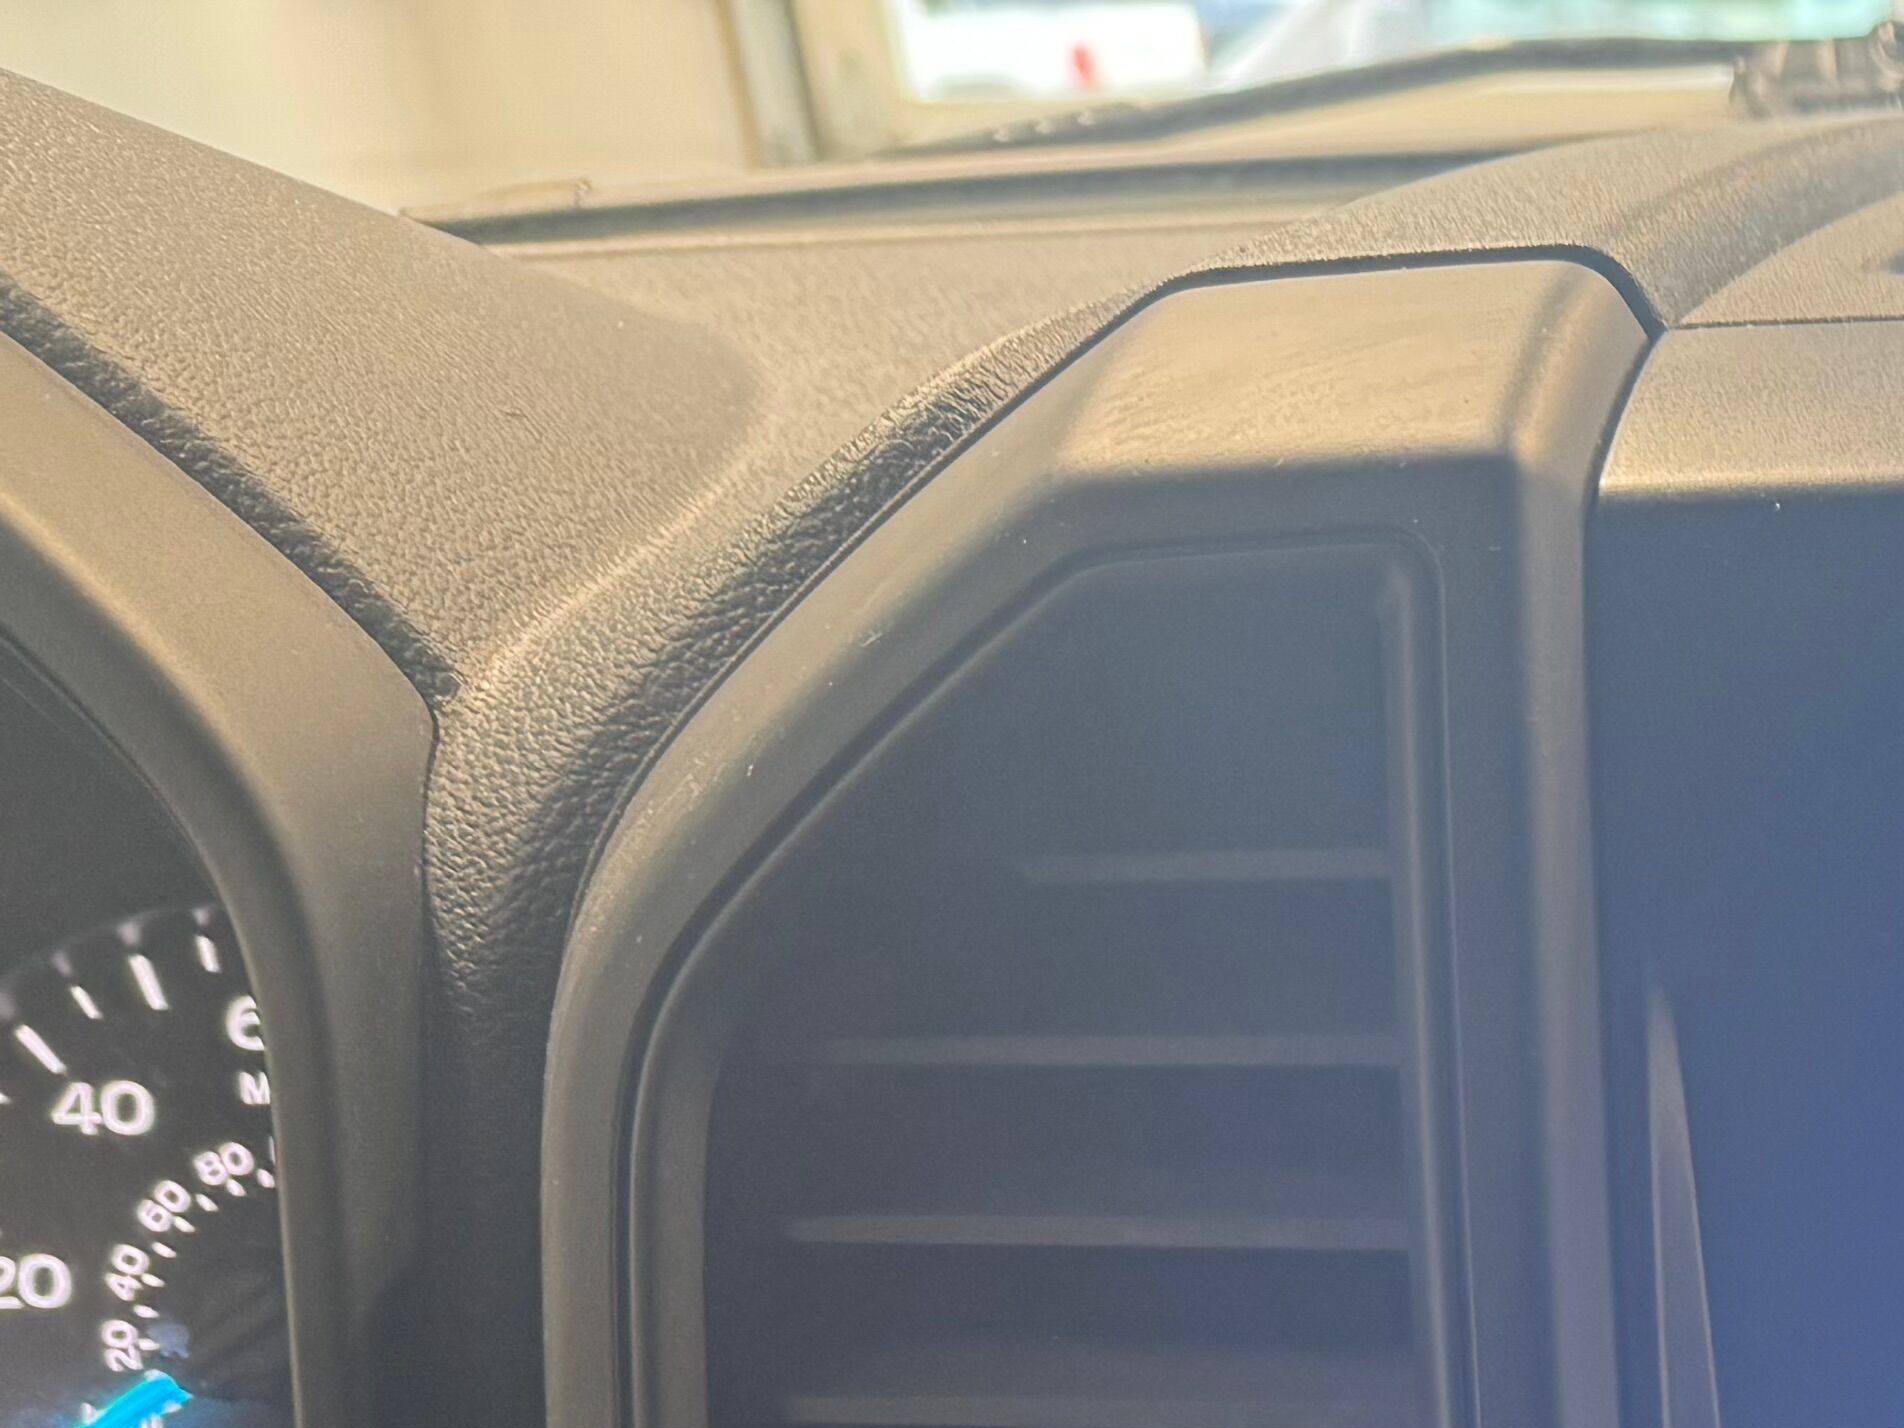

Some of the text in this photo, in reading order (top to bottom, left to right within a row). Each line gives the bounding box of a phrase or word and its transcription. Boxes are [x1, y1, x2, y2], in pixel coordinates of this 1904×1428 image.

[52, 1079, 154, 1136] 40
[194, 1141, 254, 1187] 80
[137, 1179, 191, 1234] 60
[106, 1243, 150, 1302] 40
[101, 1318, 144, 1373] 20
